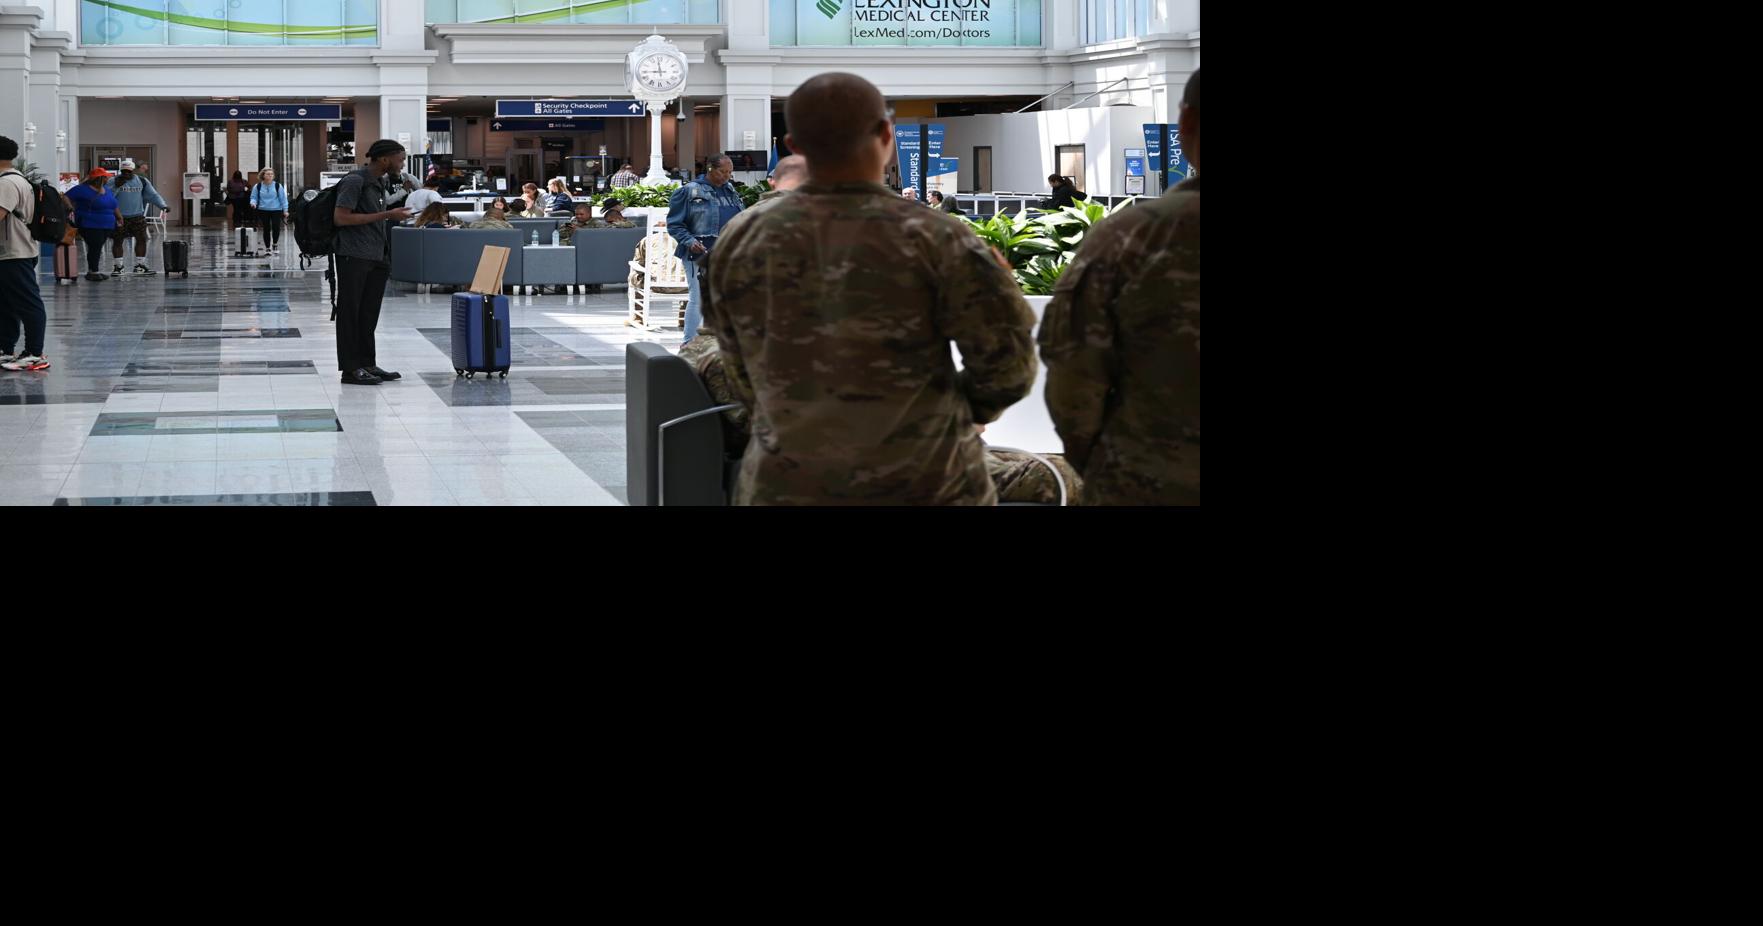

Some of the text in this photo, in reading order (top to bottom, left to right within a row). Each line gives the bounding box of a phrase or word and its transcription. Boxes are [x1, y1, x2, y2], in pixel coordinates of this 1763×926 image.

[855, 10, 990, 21] MEDICAL CENTER
[1170, 148, 1182, 165] Pre
[910, 152, 920, 191] Standard
